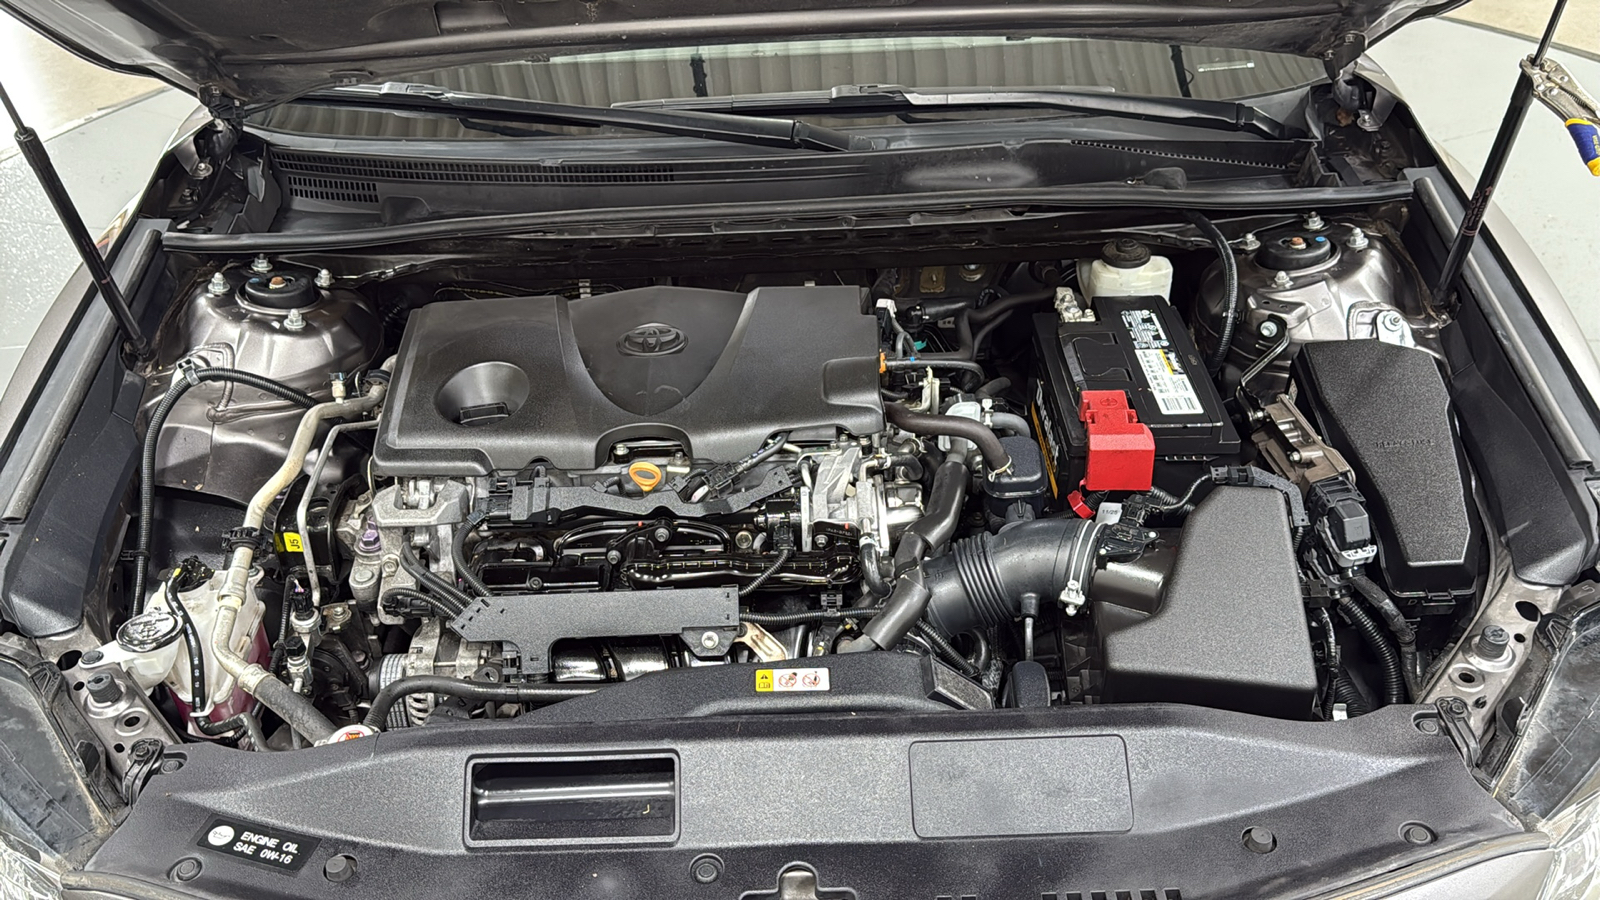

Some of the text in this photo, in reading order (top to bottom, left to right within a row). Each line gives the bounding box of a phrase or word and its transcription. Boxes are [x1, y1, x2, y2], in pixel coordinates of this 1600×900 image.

[289, 538, 300, 550] J5
[233, 841, 294, 865] SAE 0W-16
[240, 831, 299, 854] ENGINE OIL
